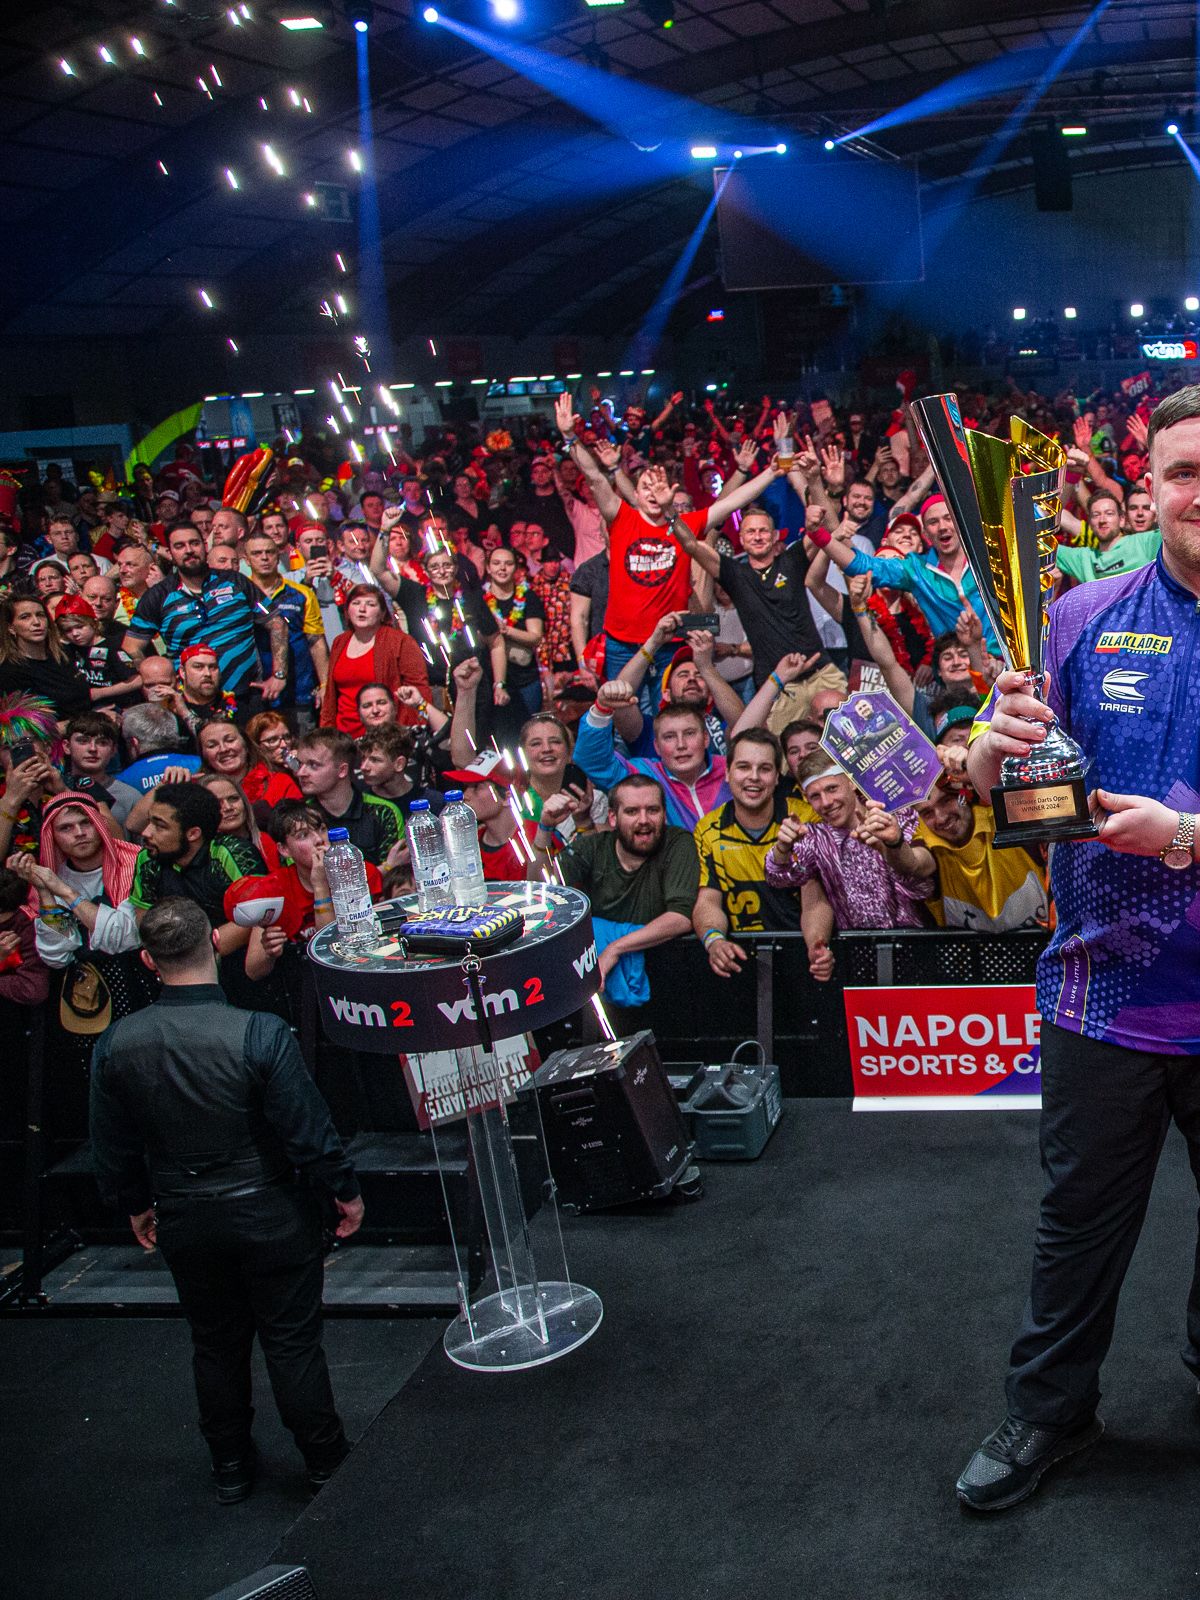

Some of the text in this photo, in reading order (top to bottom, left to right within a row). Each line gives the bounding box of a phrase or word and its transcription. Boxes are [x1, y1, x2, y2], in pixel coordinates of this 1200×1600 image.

[861, 665, 880, 682] WE
[1099, 702, 1144, 715] TARGET
[856, 727, 907, 772] LUKE LITTLER
[142, 773, 165, 789] DART
[1037, 796, 1052, 804] Darts
[1053, 794, 1069, 803] Open
[1021, 805, 1045, 813] WINNER
[437, 977, 545, 1024] vtm 2
[1069, 985, 1078, 1004] LUKE
[329, 996, 414, 1027] vtm 2
[853, 1013, 1042, 1047] NAPOLE
[860, 1053, 977, 1076] SPORTS
[984, 1053, 1007, 1075] &
